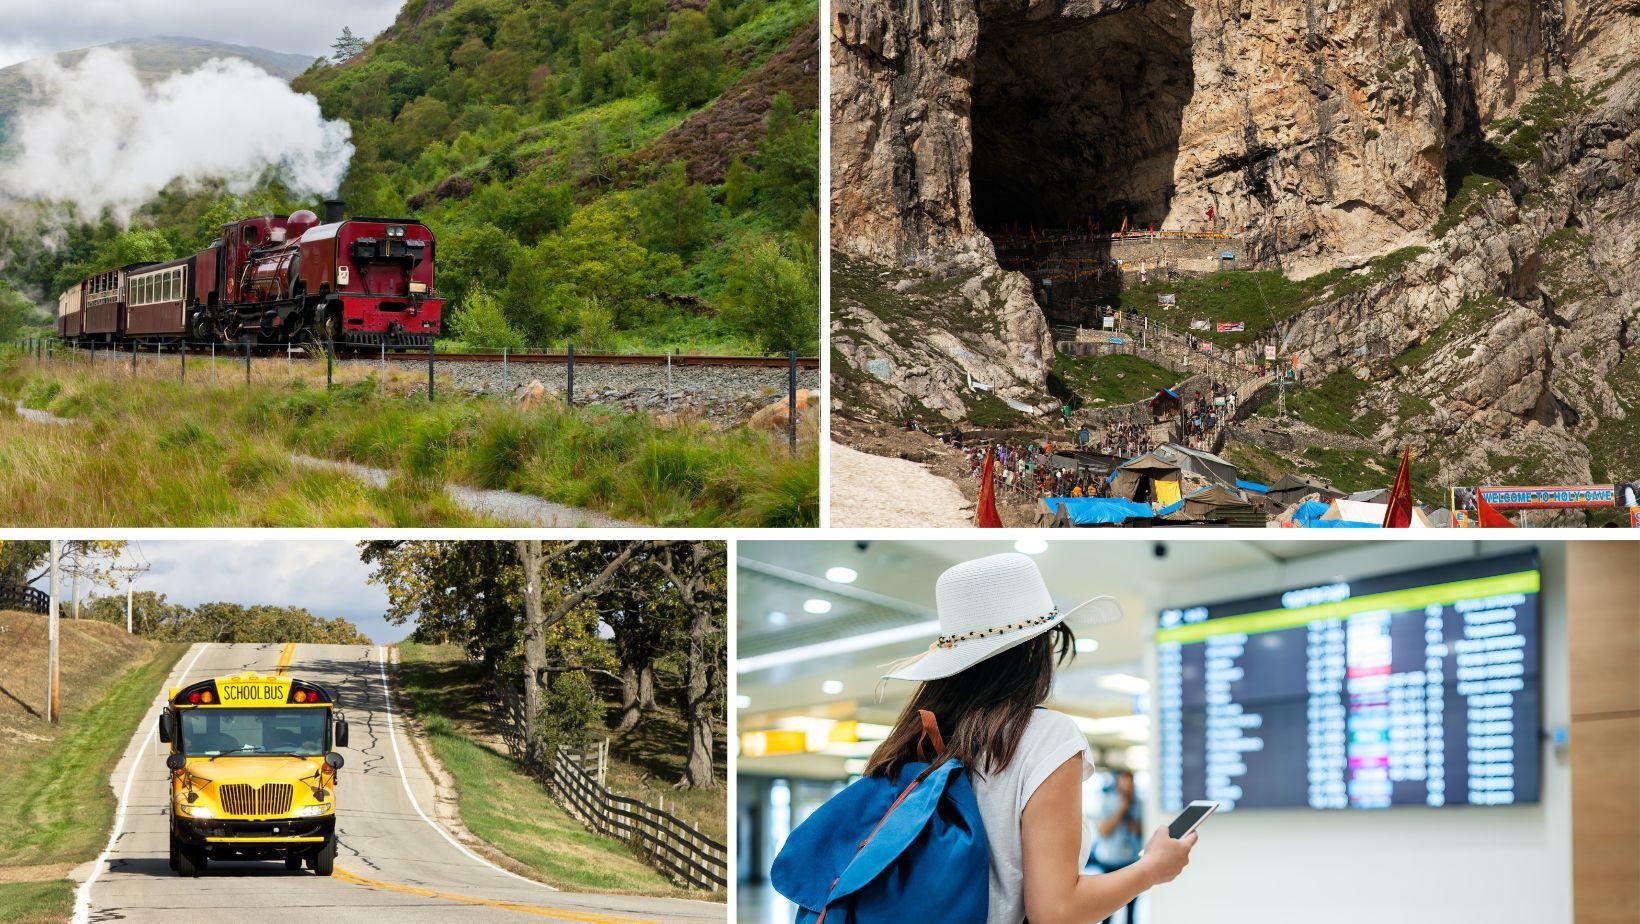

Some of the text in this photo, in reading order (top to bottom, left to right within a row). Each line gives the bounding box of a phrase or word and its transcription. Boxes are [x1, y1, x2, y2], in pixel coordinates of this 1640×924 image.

[1483, 491, 1531, 503] WELCOME
[1535, 491, 1549, 502] TO
[1554, 491, 1580, 502] HOLY
[224, 685, 284, 700] SCHOOL BUS
